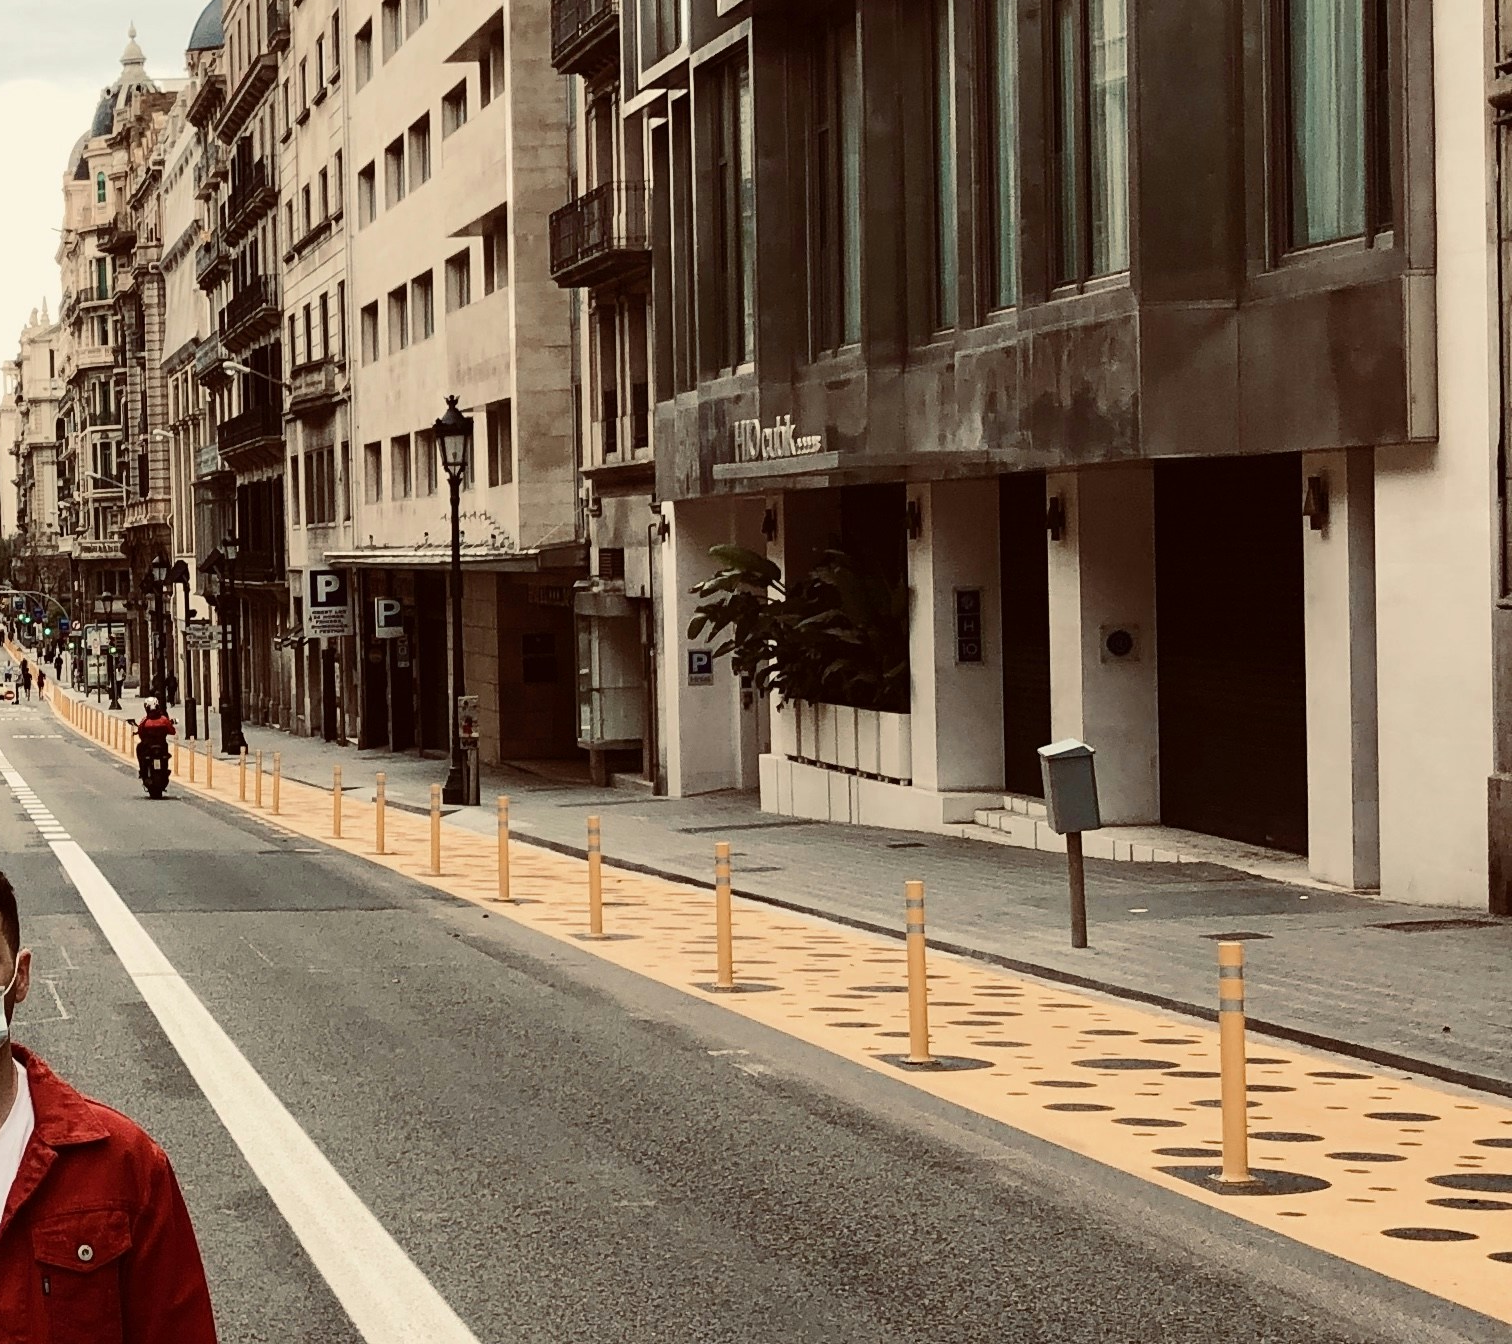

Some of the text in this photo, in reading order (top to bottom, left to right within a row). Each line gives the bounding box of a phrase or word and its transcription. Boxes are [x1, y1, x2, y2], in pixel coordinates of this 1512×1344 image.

[317, 575, 340, 602] P
[378, 599, 400, 627] P
[693, 654, 708, 672] P
